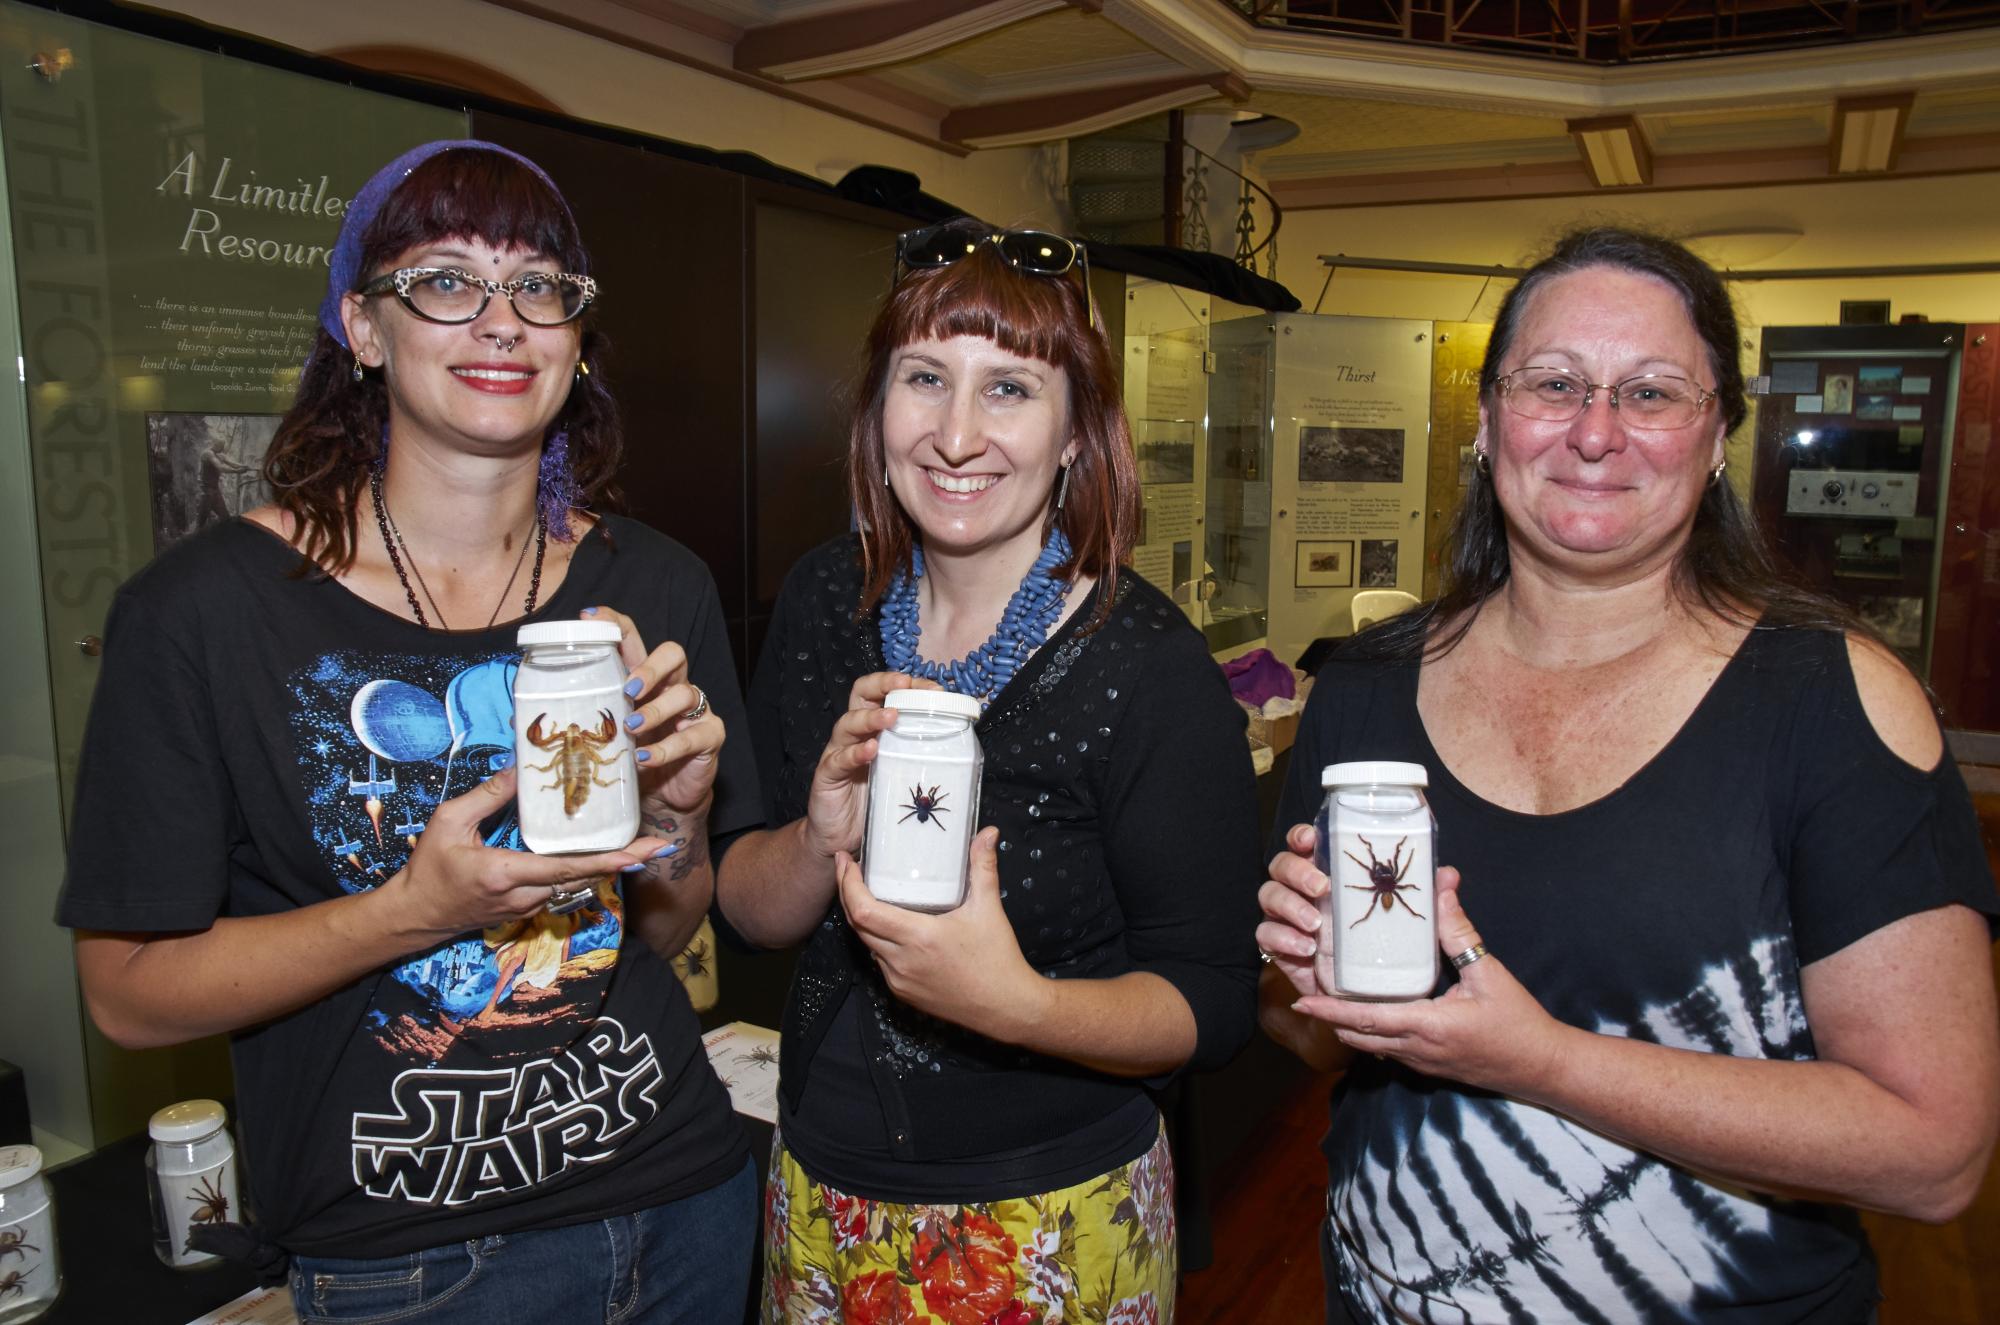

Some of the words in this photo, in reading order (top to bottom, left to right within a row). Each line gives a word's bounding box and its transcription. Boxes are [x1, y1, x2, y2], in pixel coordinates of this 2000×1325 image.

[11, 99, 97, 254] THE
[156, 151, 196, 195] A
[210, 157, 353, 217] Limitles
[179, 208, 335, 266] Resourc
[156, 297, 185, 311] there
[189, 301, 198, 312] is
[201, 306, 215, 314] an
[219, 304, 265, 318] immense
[161, 317, 188, 331] their
[192, 320, 243, 339] uniformly
[246, 326, 285, 342] greyish
[140, 356, 166, 370] lend
[169, 358, 186, 371] the
[190, 358, 244, 377] landscape
[247, 366, 256, 374] a
[257, 362, 276, 375] sad
[177, 338, 213, 356] thorny
[216, 345, 256, 359] grasses
[260, 343, 290, 357] which
[1336, 365, 1376, 383] Thirst
[27, 280, 121, 608] FORESTS
[352, 1016, 654, 1144] STAR
[352, 1057, 666, 1205] WARS
